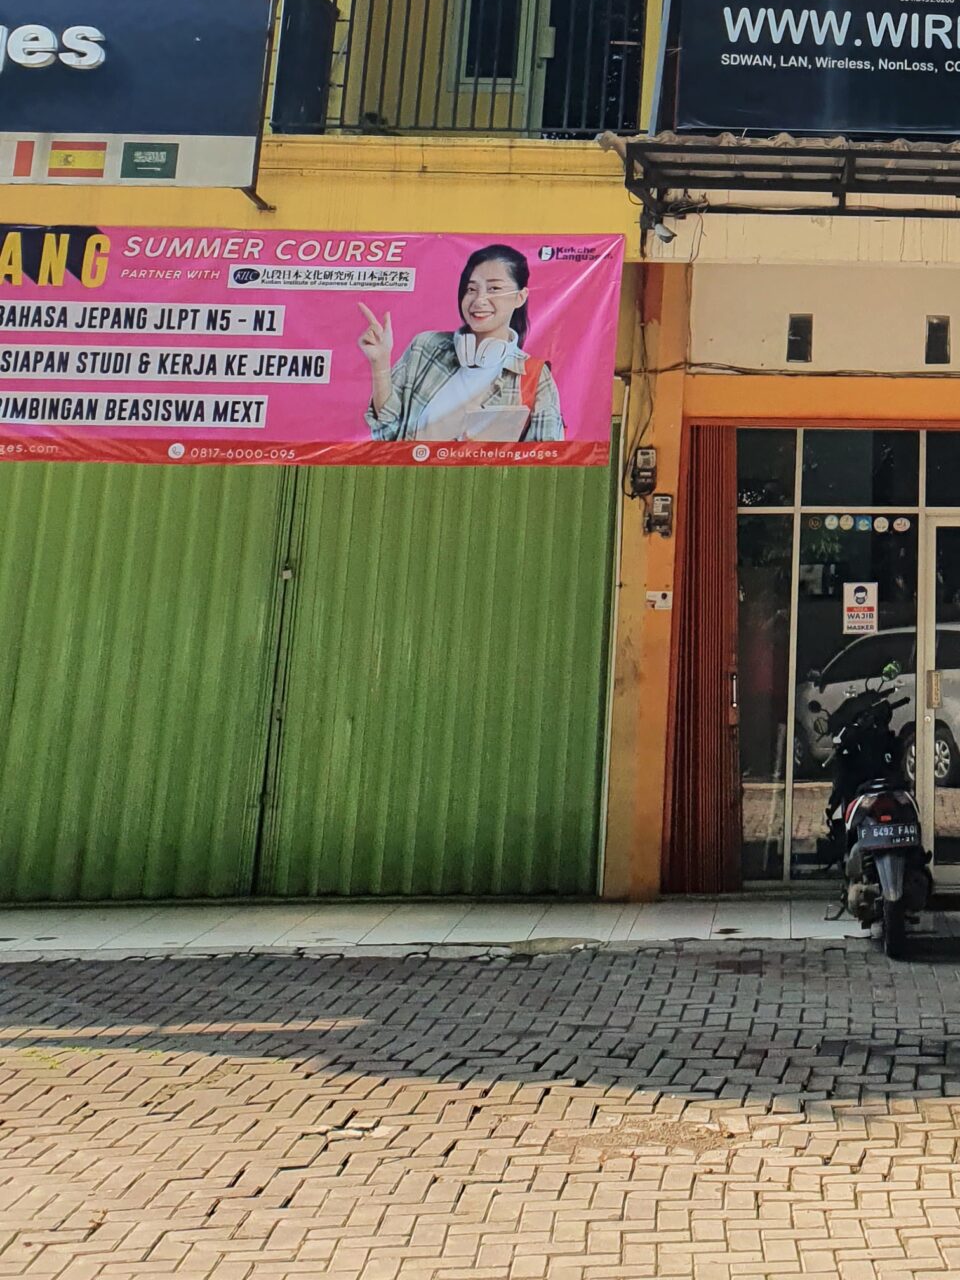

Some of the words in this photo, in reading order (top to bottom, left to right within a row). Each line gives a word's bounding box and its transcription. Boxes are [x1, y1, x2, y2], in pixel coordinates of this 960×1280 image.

[0, 24, 106, 74] es
[721, 53, 776, 68] SDWAN,
[780, 55, 812, 69] LAN,
[815, 56, 874, 71] Wireless,
[878, 59, 938, 73] NonLoss,
[0, 231, 111, 288] ANG
[123, 236, 264, 259] SUMMER
[275, 239, 407, 262] COURSE
[120, 269, 182, 279] PARTNER
[187, 270, 221, 280] WITH
[75, 307, 147, 330] JEPANG
[154, 308, 200, 331] JLPT
[206, 309, 231, 332] N5
[253, 310, 277, 332] N1
[76, 351, 131, 373] STUDI
[138, 353, 151, 374] &
[157, 353, 220, 376] KERJA
[225, 354, 248, 376] KE
[253, 355, 325, 378] JEPANG
[0, 397, 98, 421] IMBINGAN
[104, 399, 205, 422] BEASISWA
[212, 400, 264, 423] MEXT
[190, 447, 296, 459] 0817-6000-095
[436, 447, 559, 460] @kukchelanguages
